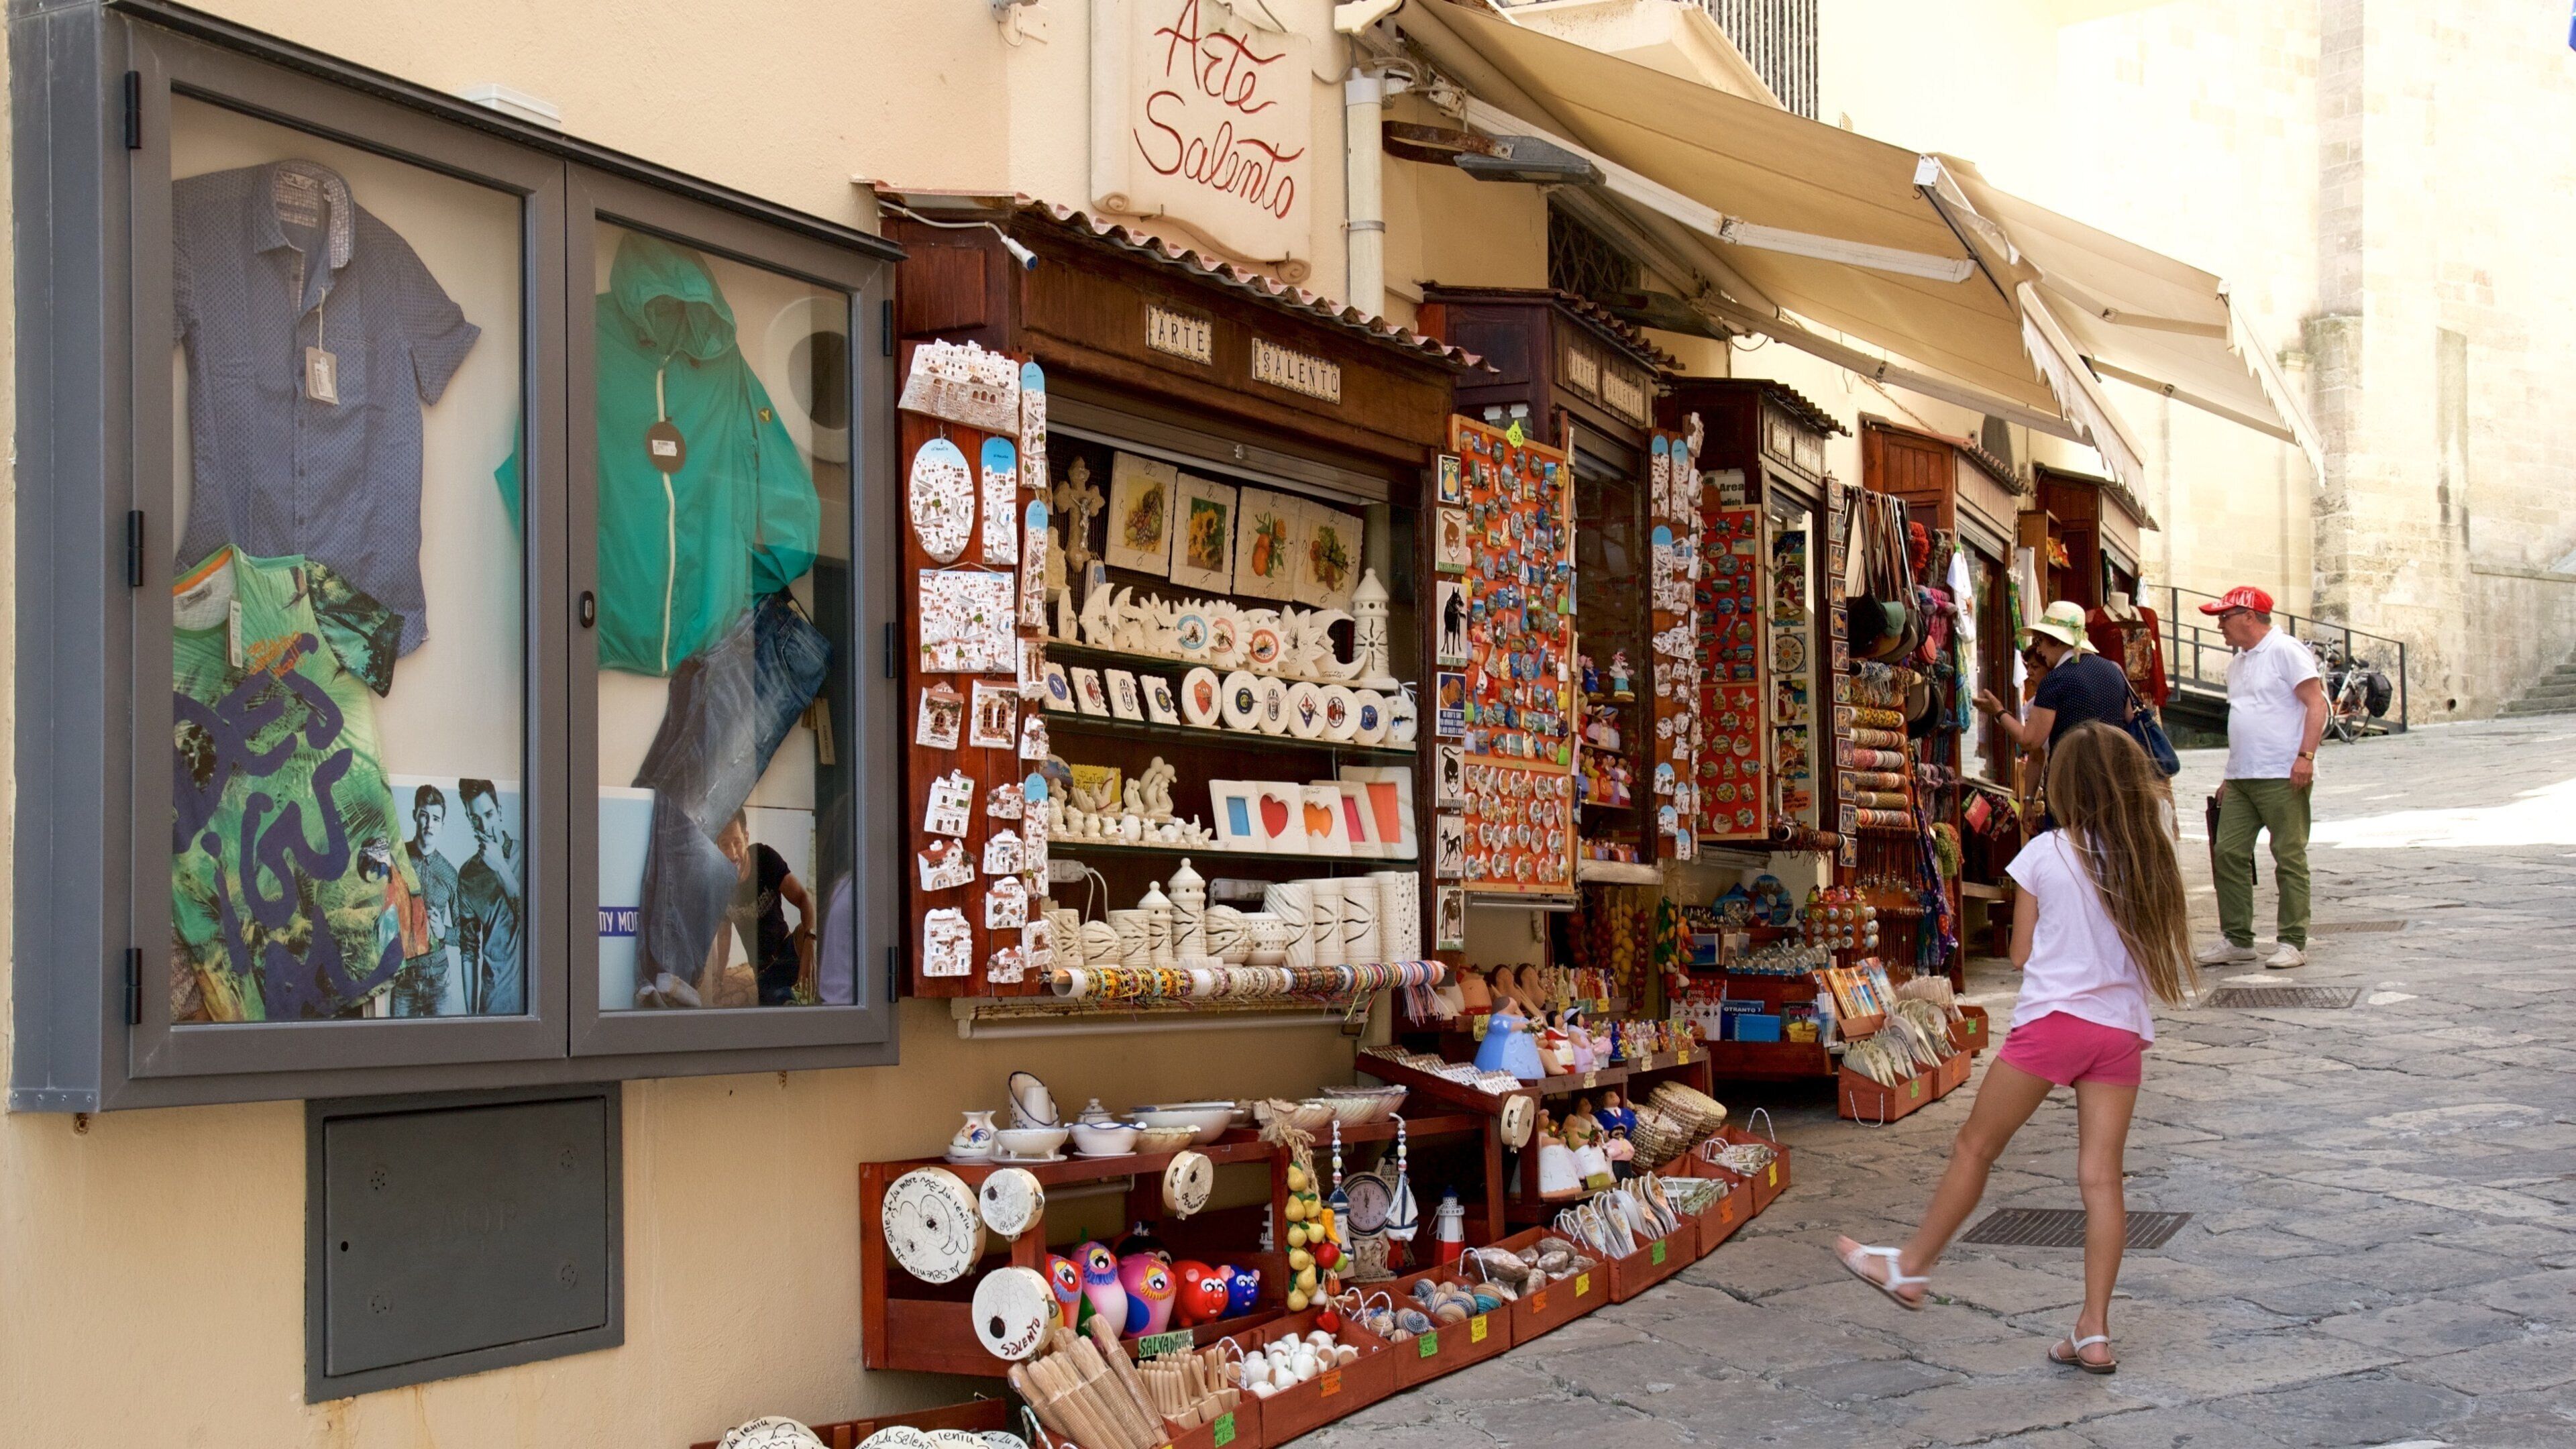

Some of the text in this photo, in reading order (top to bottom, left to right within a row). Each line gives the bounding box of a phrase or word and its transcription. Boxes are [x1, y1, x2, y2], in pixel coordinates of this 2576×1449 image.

[1153, 0, 1286, 114] Arte
[1132, 90, 1305, 219] Salento
[1158, 318, 1338, 393] ARTE SALENTO
[1719, 483, 1745, 492] Area
